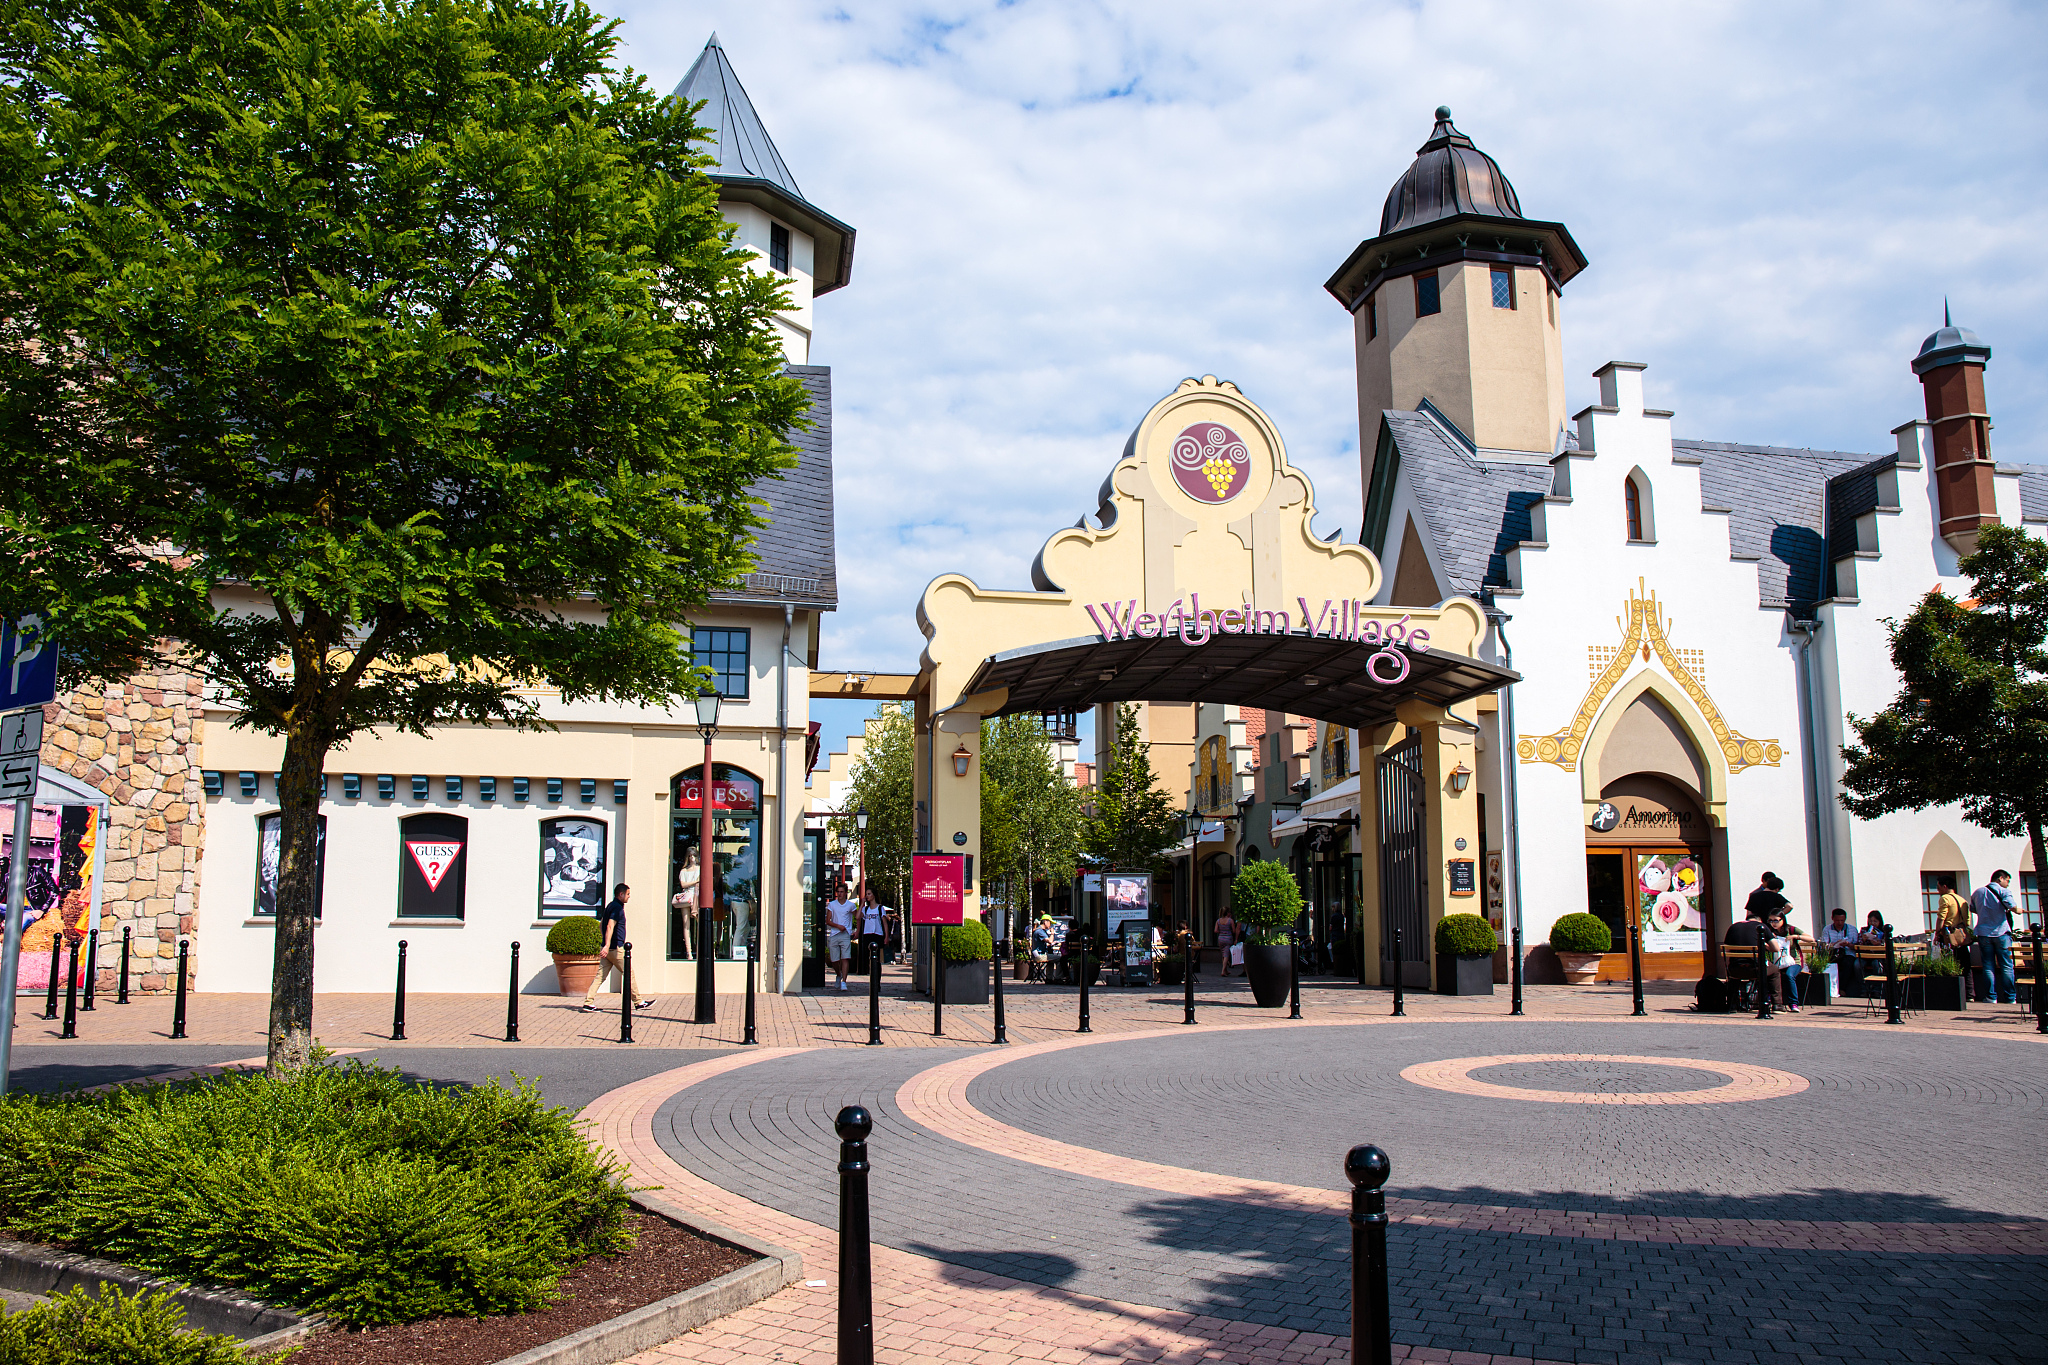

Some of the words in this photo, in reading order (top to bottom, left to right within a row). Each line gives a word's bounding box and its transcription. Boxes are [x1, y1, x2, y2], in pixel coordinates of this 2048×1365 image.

[1084, 592, 1291, 646] Wertheim
[1297, 596, 1431, 684] Village
[10, 612, 46, 695] P
[686, 787, 748, 802] GESS
[1623, 804, 1692, 825] Amorino
[415, 845, 454, 856] GUESS
